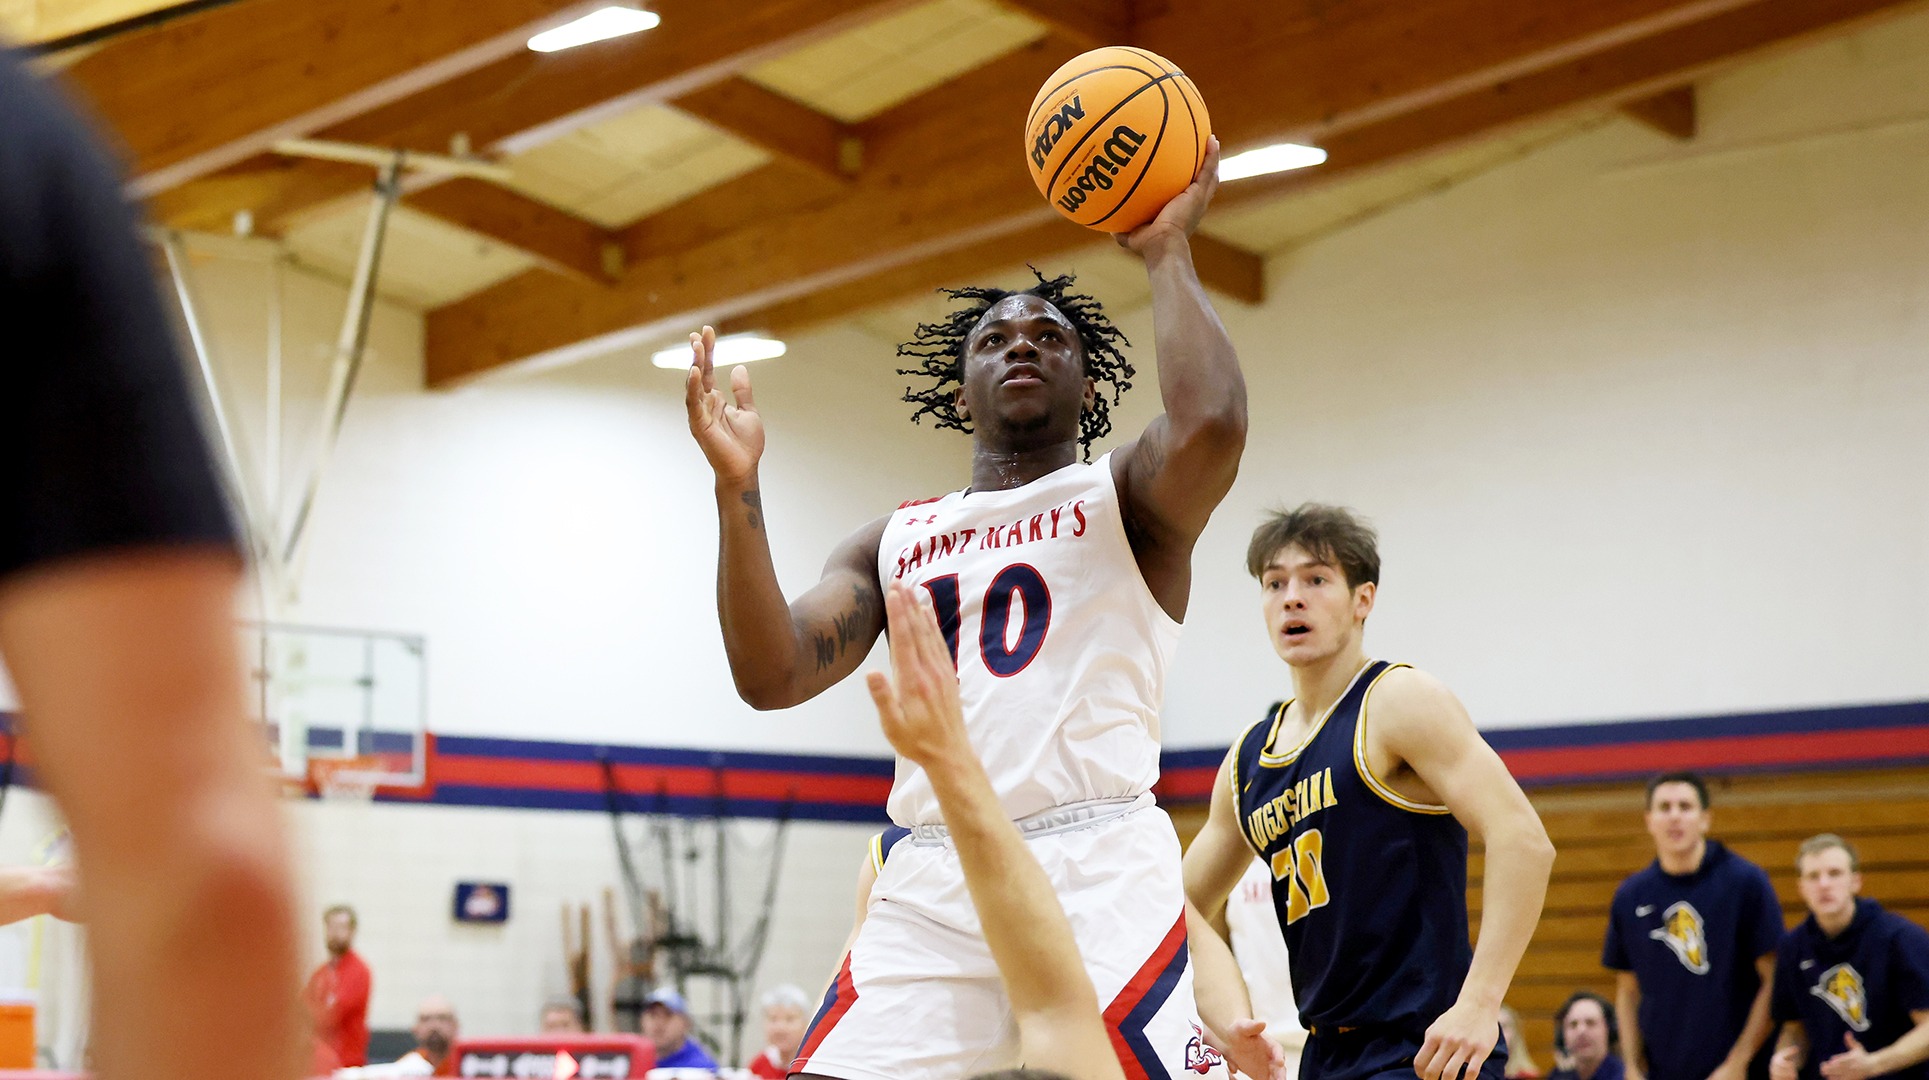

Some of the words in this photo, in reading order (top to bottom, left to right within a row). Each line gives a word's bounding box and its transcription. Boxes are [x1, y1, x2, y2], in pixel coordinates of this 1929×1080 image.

[1031, 95, 1086, 171] NCAA
[1057, 125, 1147, 213] Wilson
[894, 528, 977, 579] SAINT
[979, 500, 1086, 550] MARY'S
[920, 562, 1052, 686] 10
